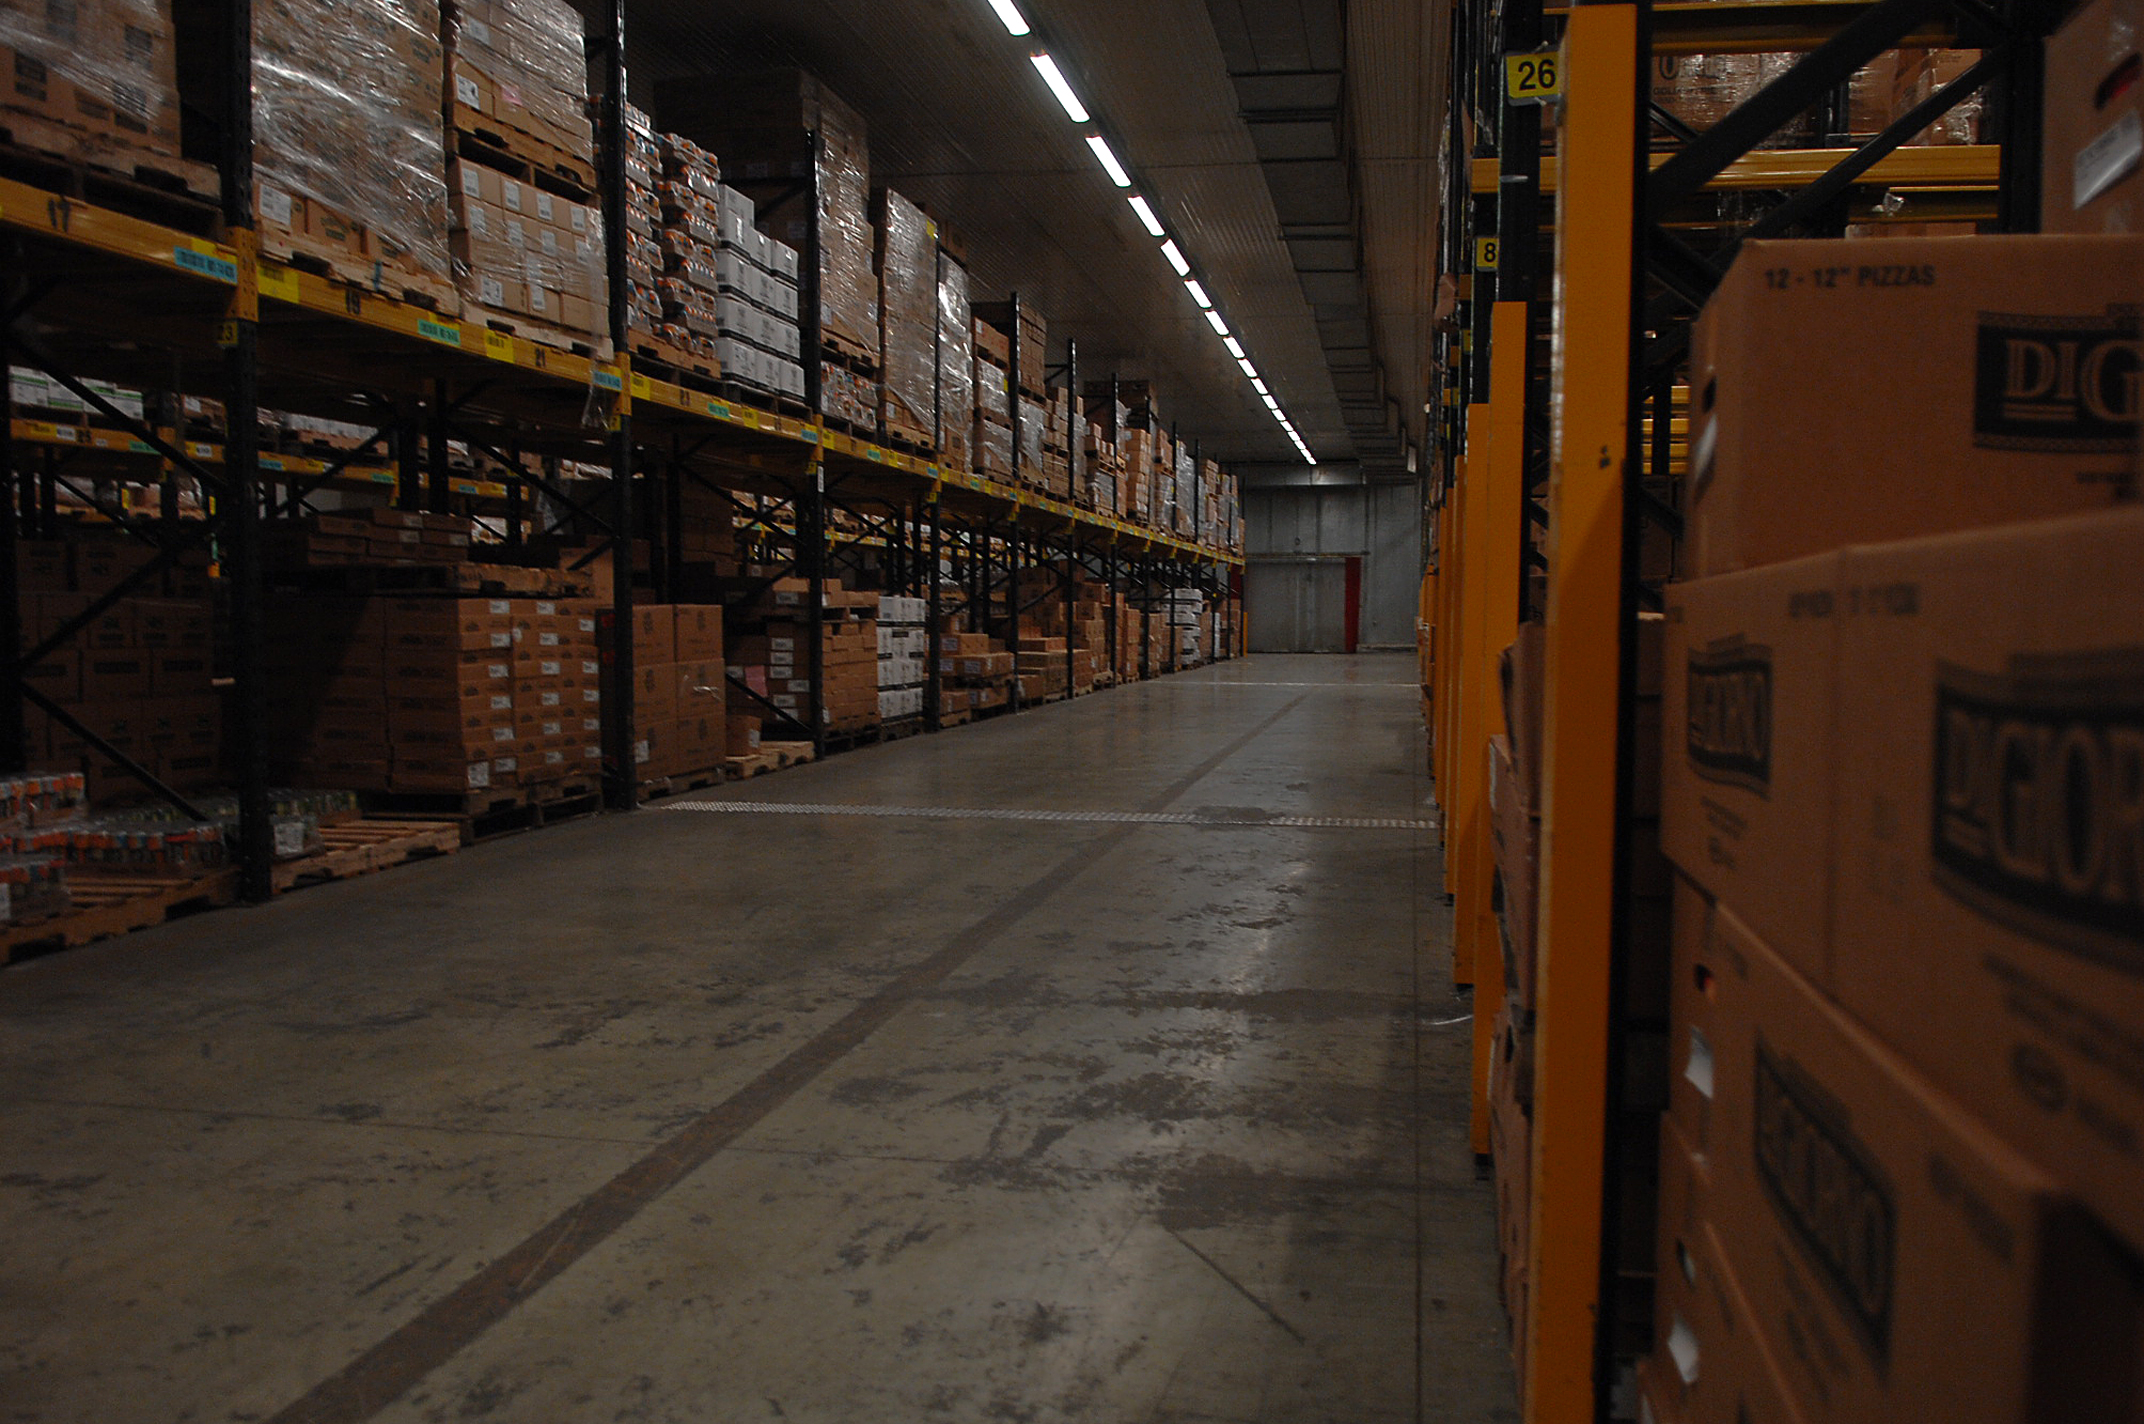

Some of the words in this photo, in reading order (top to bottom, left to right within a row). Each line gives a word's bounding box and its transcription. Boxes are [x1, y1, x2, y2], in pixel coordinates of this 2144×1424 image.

[1518, 58, 1556, 91] 26
[1483, 241, 1497, 264] 8
[1765, 267, 1790, 290] 12
[1858, 263, 1937, 287] PIZZAS
